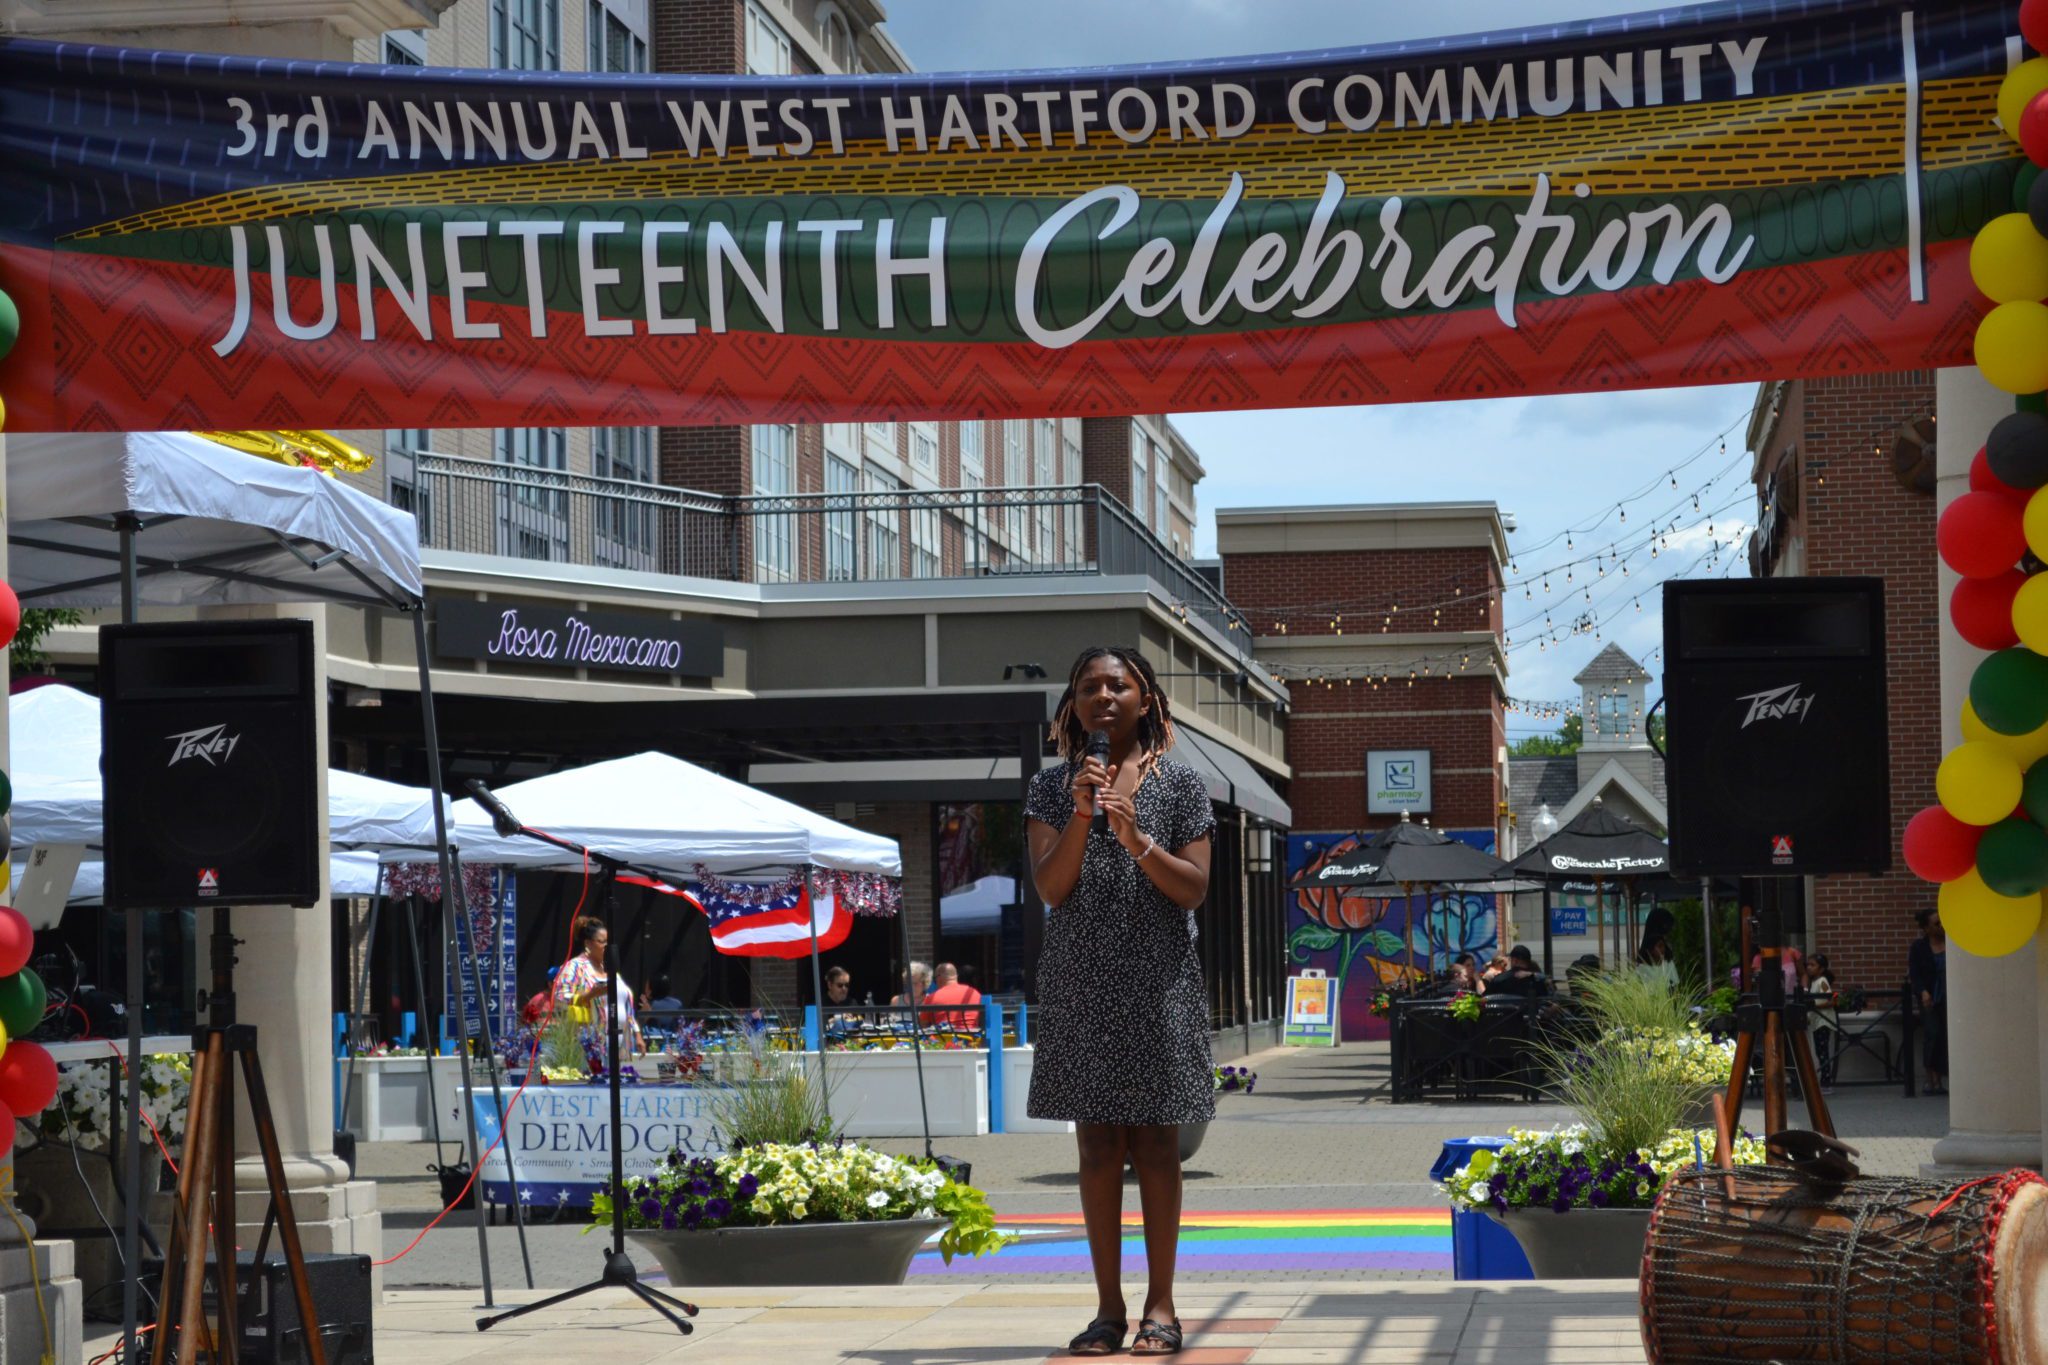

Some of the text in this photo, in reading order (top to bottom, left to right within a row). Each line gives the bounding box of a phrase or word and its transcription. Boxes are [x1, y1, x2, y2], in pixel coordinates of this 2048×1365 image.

[226, 36, 1768, 160] 3rd ANNUAL WEST HARTFORD COMMUNITY
[211, 171, 1754, 359] JUNETEENTH Celebration
[488, 609, 682, 669] Rosa Mexicano
[1377, 791, 1424, 801] pharmacy
[1560, 921, 1586, 930] HERE
[1564, 912, 1581, 920] PAY
[520, 1095, 743, 1118] WEST HARTFO
[519, 1122, 727, 1153] DEMOCRA
[513, 1157, 574, 1170] Community
